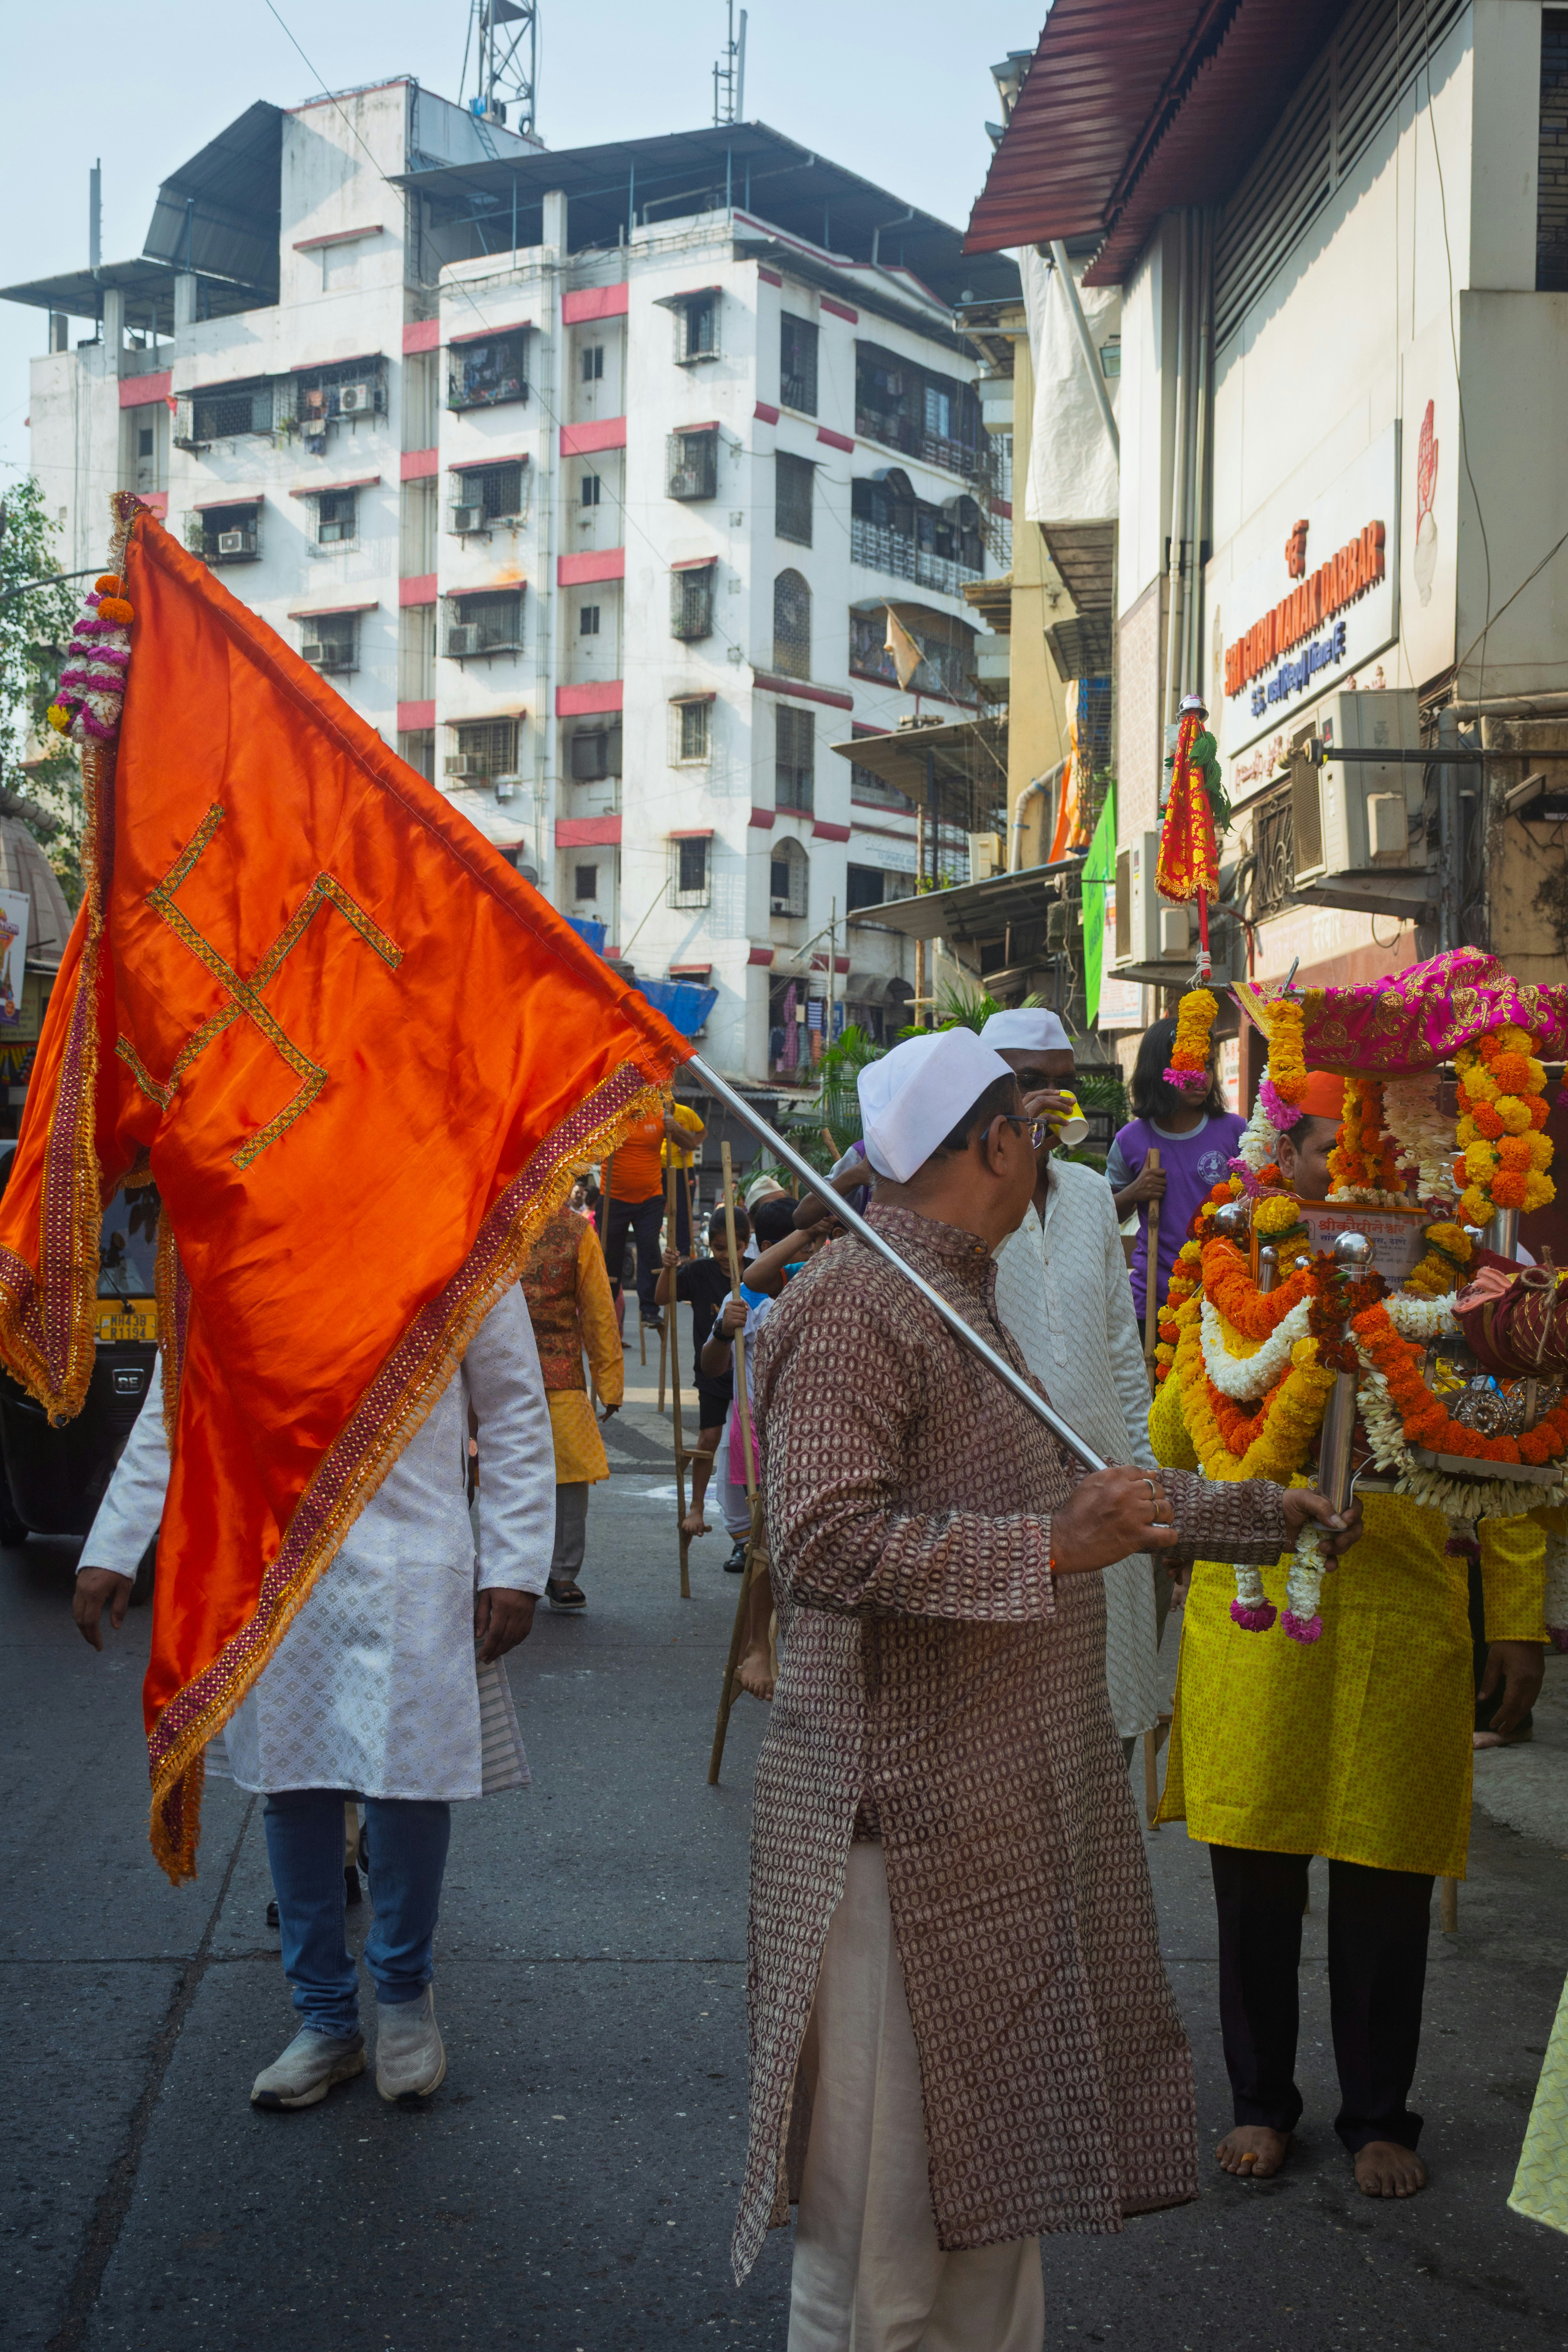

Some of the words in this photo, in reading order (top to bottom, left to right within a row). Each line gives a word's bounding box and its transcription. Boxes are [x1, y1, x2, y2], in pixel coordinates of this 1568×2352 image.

[1243, 609, 1276, 683] GURU
[1275, 570, 1321, 656] NANAK
[1320, 520, 1385, 619] DARBAR
[1389, 1237, 1406, 1245] ठाणे
[111, 1327, 145, 1338] R1194
[118, 1377, 138, 1388] RE
